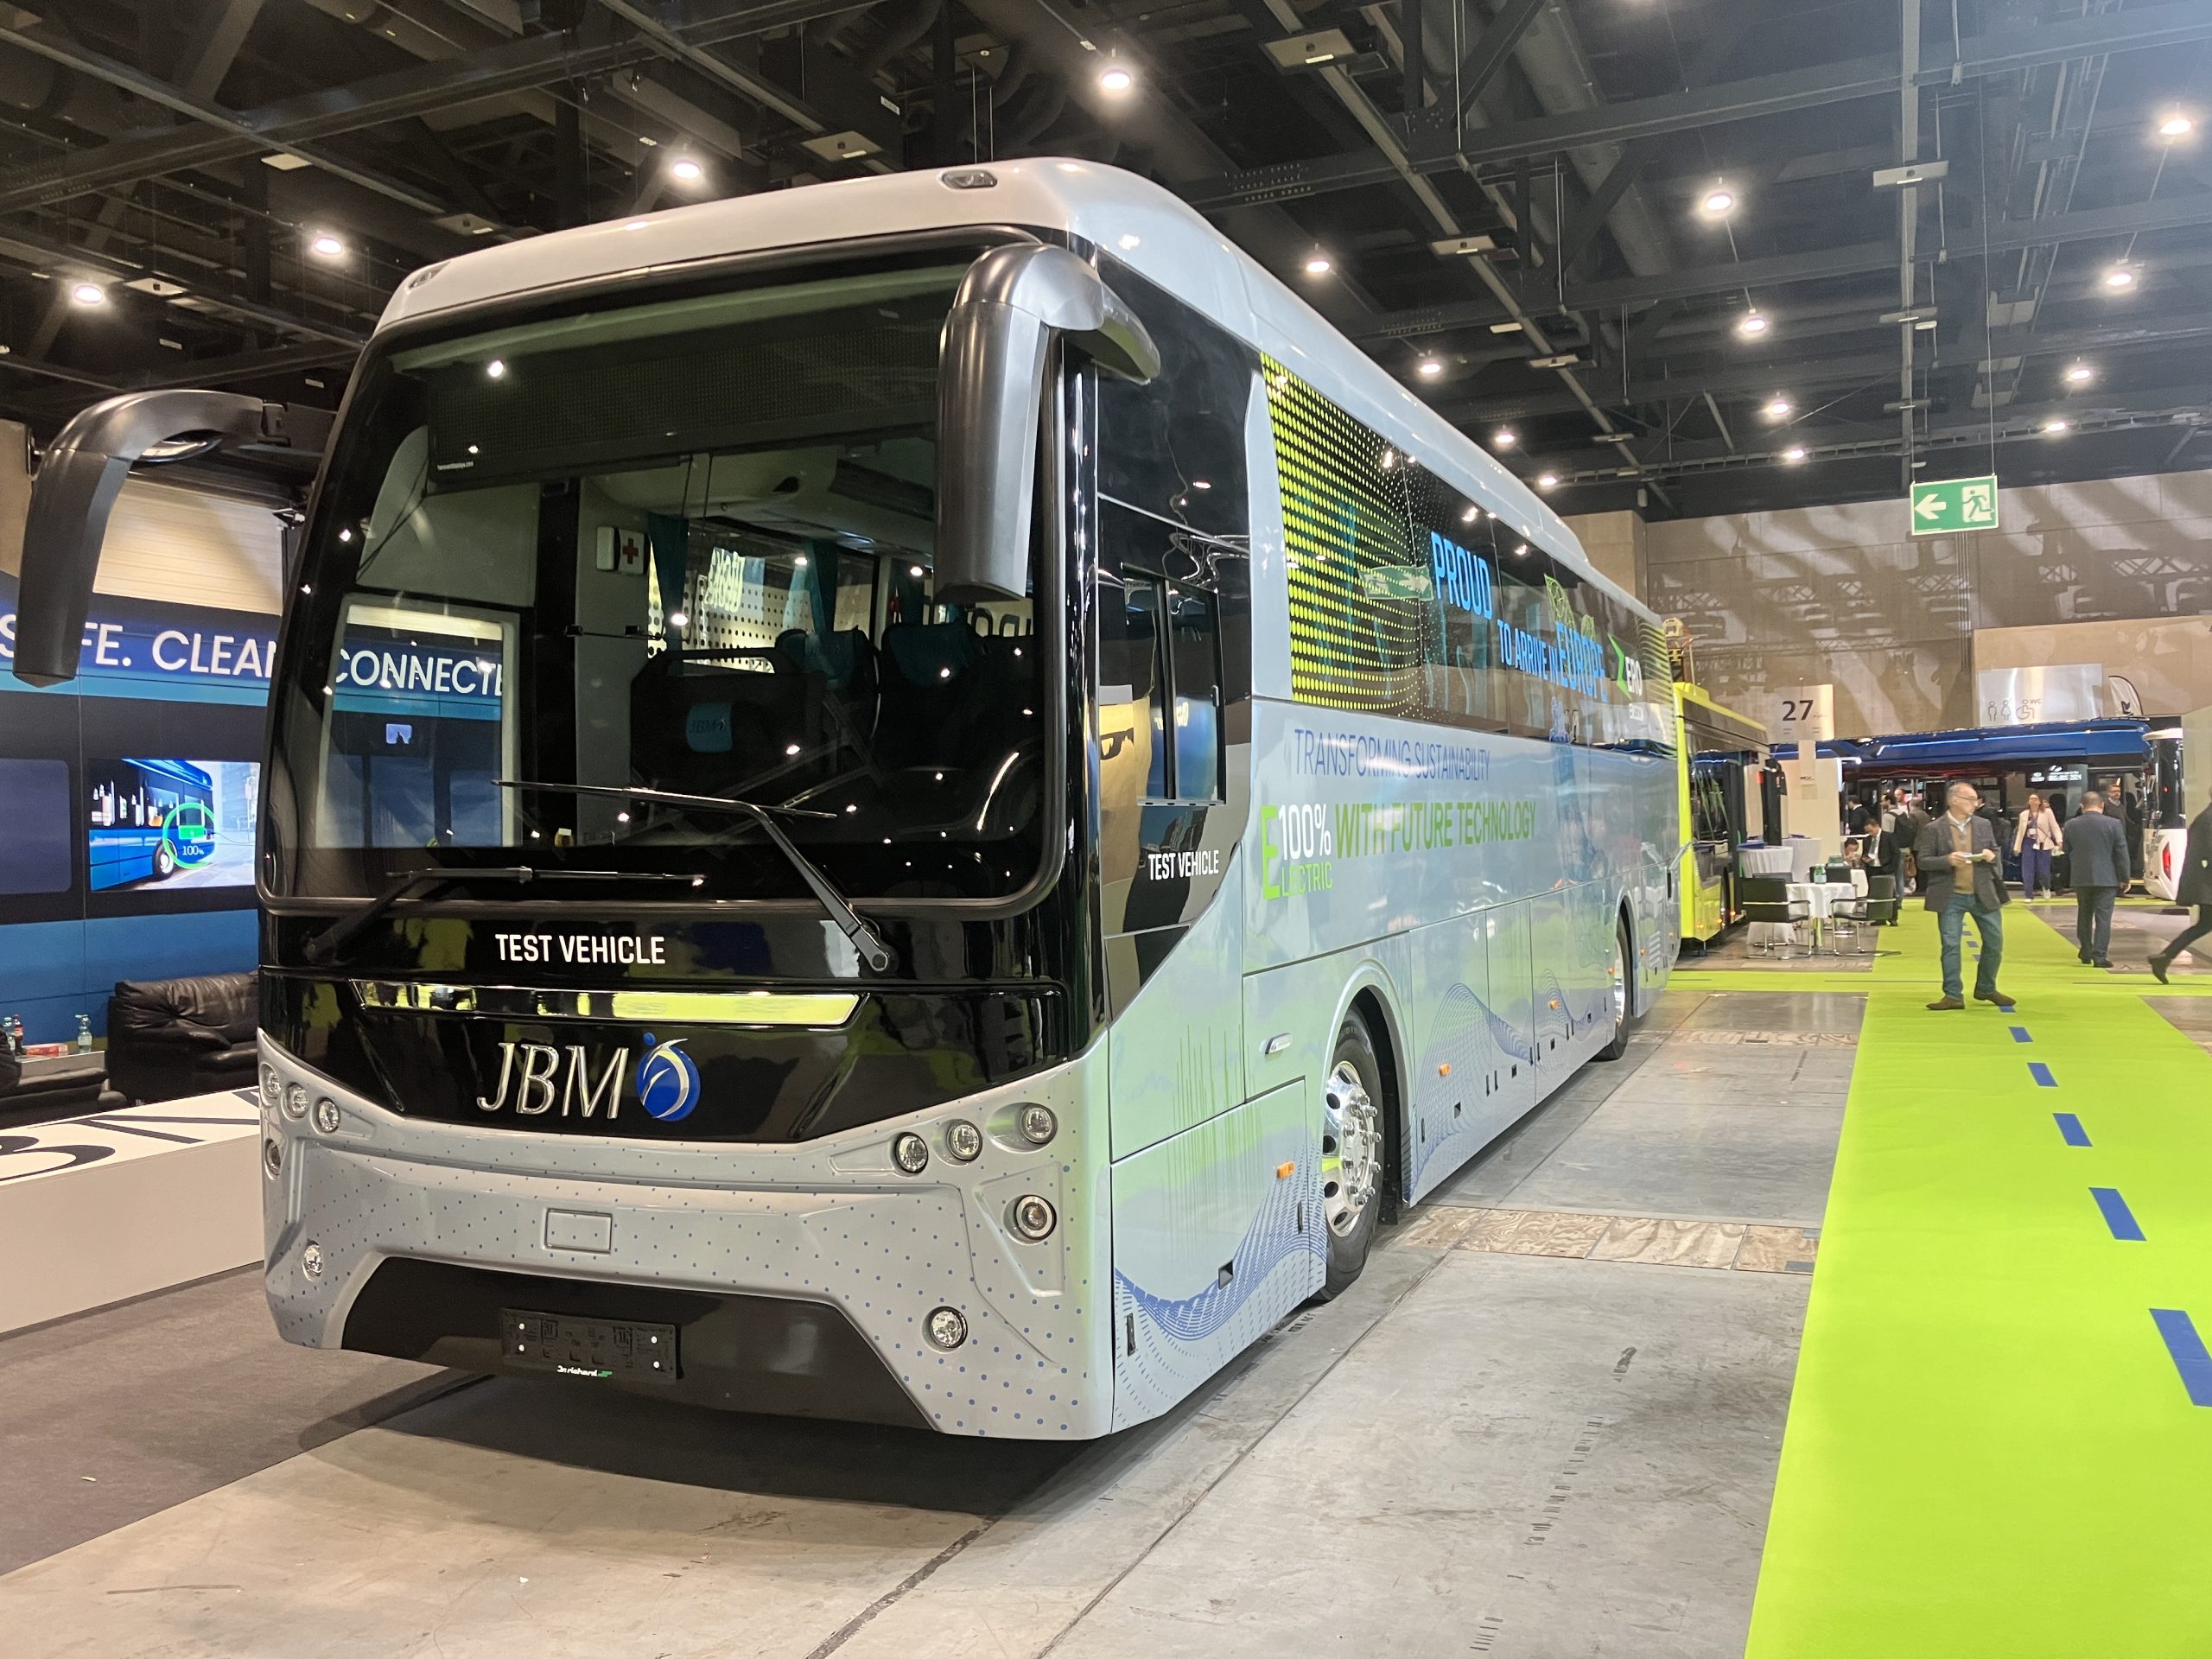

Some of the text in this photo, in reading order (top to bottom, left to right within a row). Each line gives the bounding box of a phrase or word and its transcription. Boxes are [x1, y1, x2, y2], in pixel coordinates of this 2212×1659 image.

[1430, 531, 1494, 620] PROUD
[0, 613, 131, 667] SE.
[1497, 619, 1608, 703] TO ARRIVE IN EUROPE
[1783, 699, 1814, 721] 27
[1294, 728, 1491, 782] TRANSFORMING SUSTAINABILITY
[182, 845, 204, 856] 100%
[1278, 800, 1536, 861] 100% WITH FUTURE TECHNOLOGY
[1147, 849, 1220, 880] TEST VEHICLE
[495, 933, 666, 964] TEST VEHICLE
[476, 1042, 630, 1119] JBM
